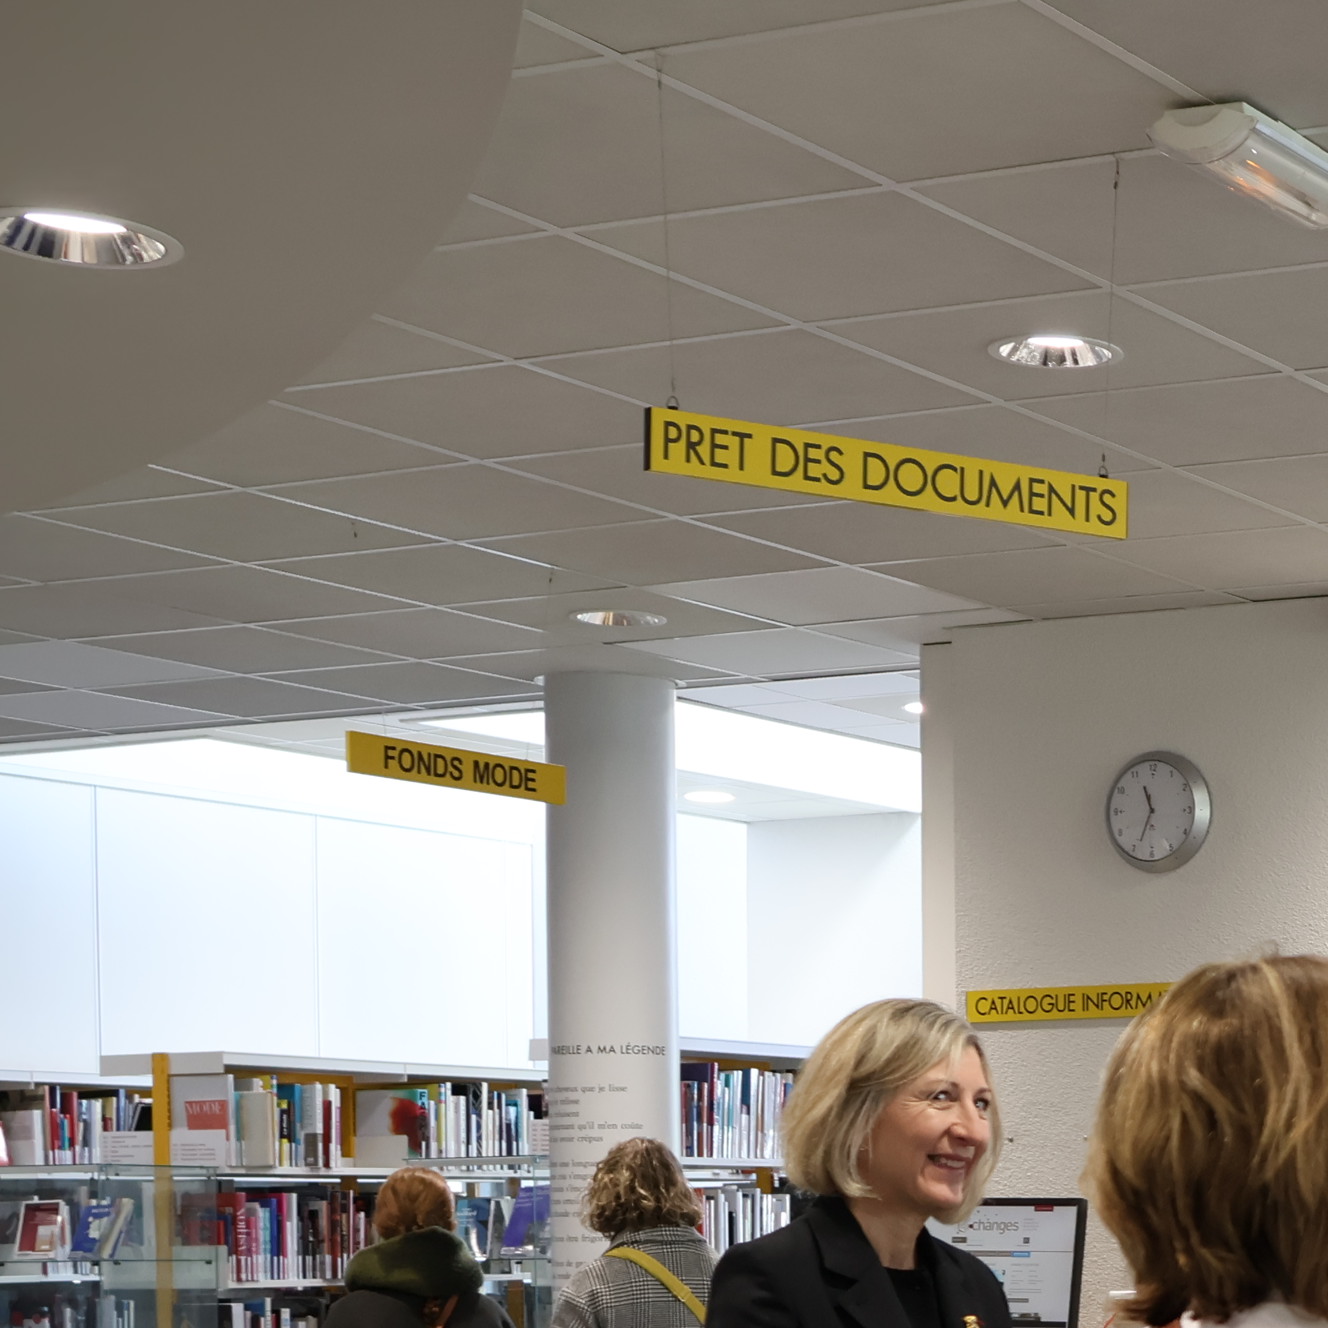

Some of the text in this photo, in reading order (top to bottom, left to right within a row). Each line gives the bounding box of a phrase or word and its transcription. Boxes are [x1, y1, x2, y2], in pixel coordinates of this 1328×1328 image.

[662, 420, 1117, 527] PRET DES DOCUMENTS
[383, 745, 537, 793] FONDS MODE
[975, 990, 1166, 1016] CATALOGUE INFORM
[585, 1045, 593, 1055] A
[596, 1045, 616, 1055] MA
[620, 1042, 666, 1056] LÉGENDE
